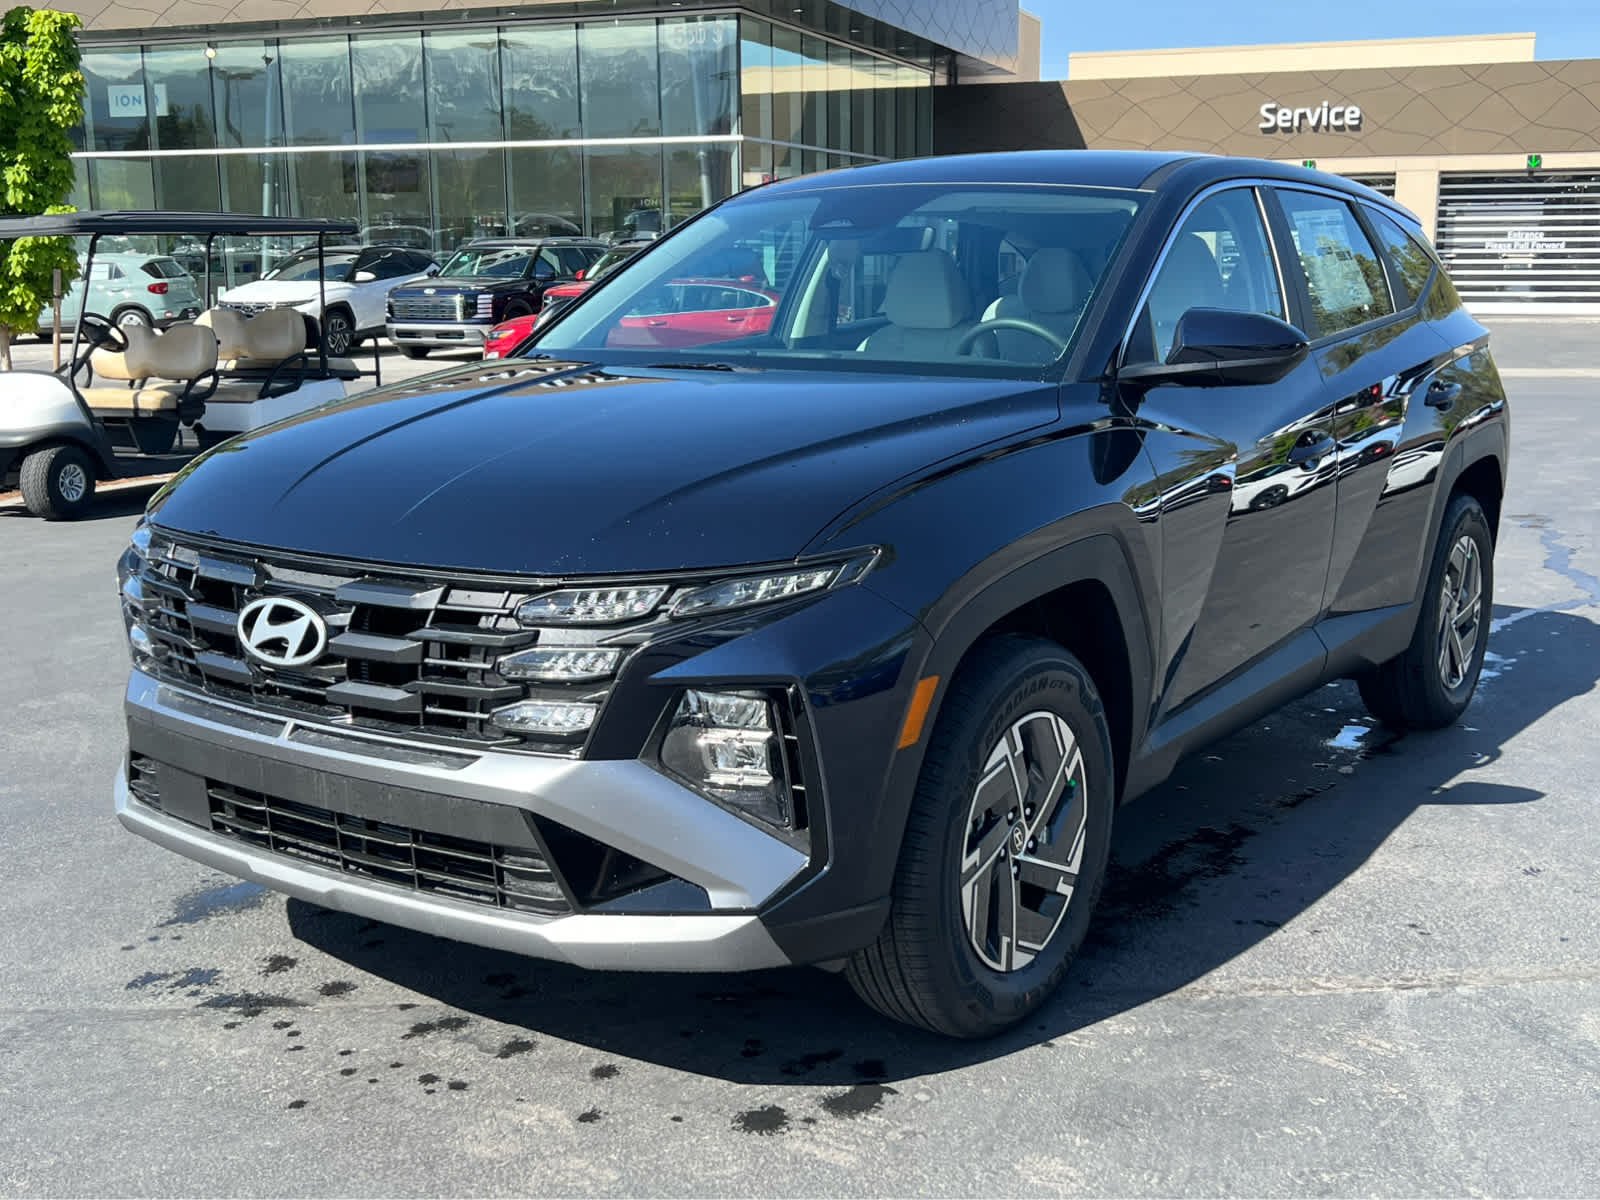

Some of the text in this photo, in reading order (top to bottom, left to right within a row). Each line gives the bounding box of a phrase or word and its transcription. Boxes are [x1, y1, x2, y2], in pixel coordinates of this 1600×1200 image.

[1259, 100, 1361, 130] Service
[1507, 231, 1545, 240] Entrance
[1531, 240, 1566, 250] Forward
